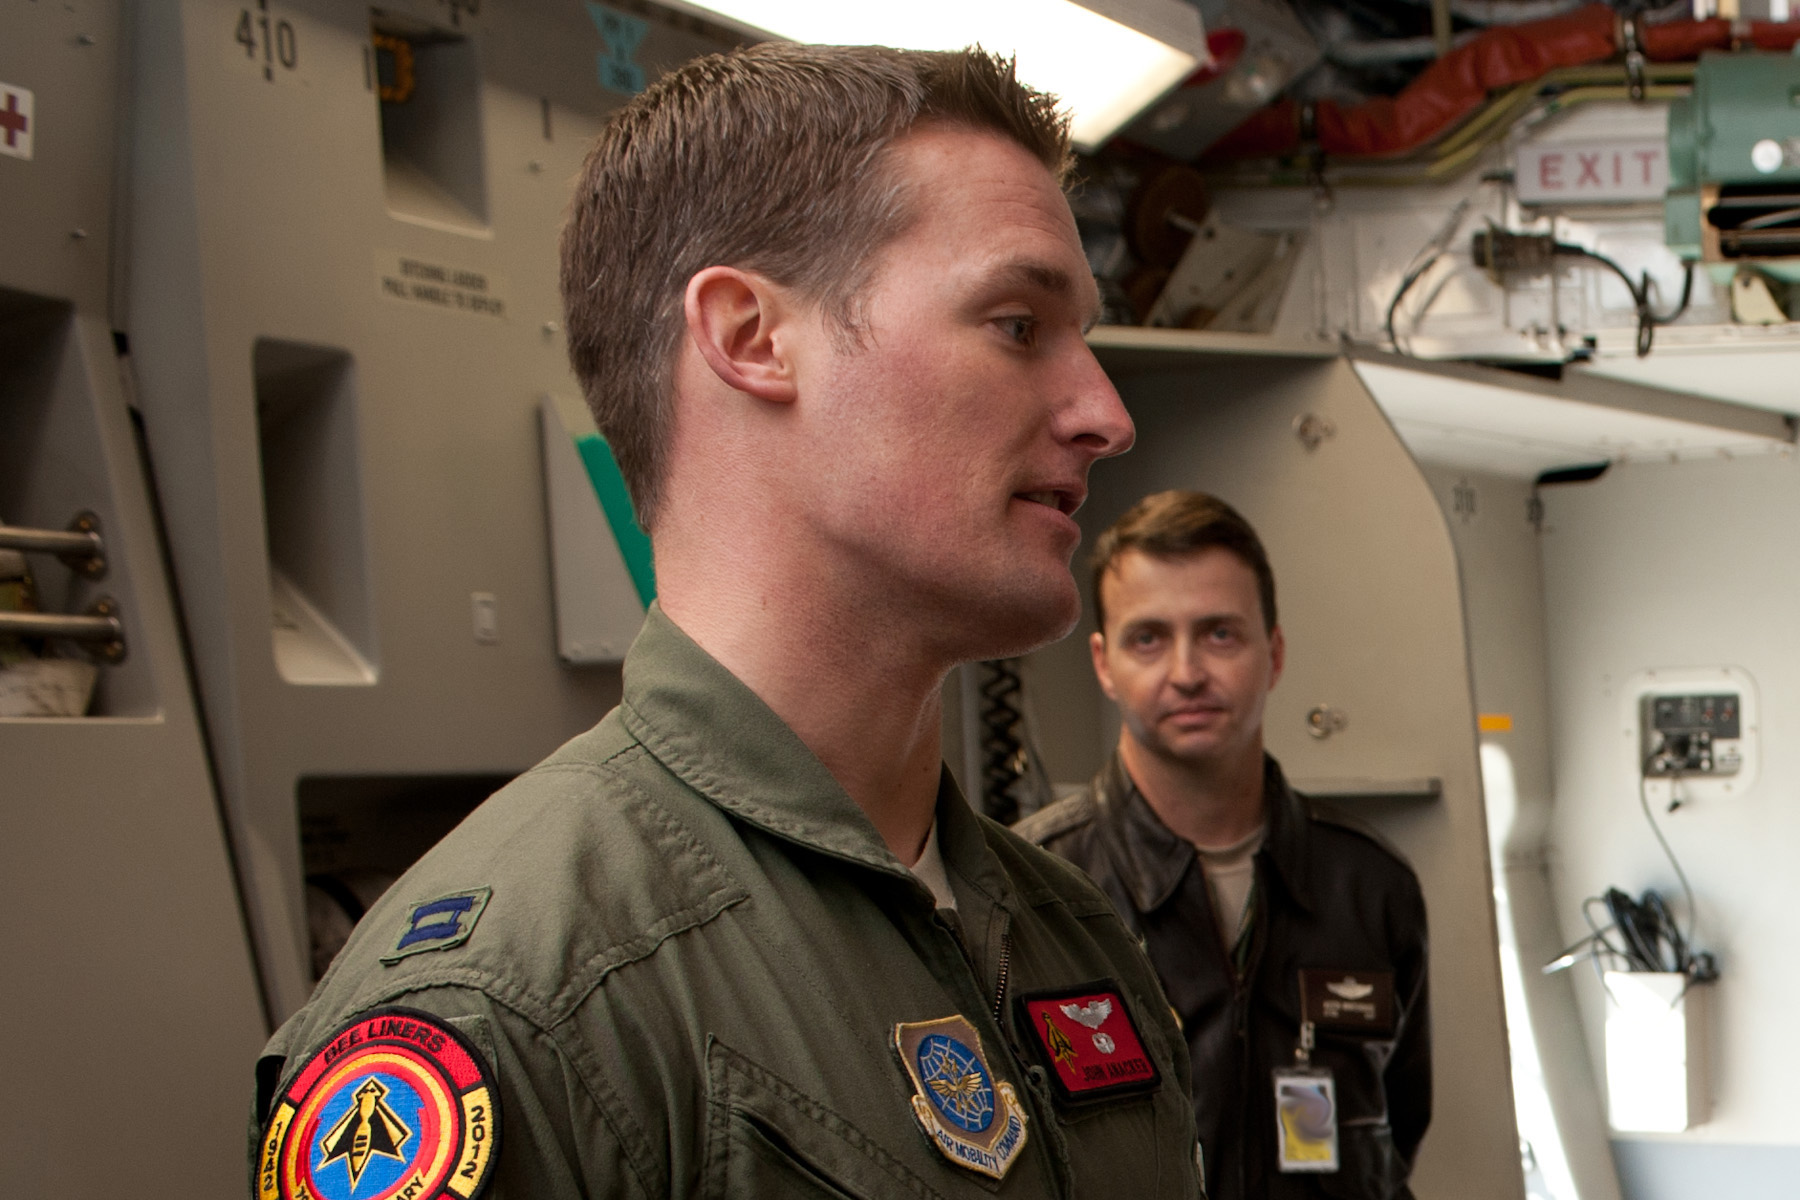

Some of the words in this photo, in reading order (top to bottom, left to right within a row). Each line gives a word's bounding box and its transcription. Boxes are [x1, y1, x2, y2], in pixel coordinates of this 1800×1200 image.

[235, 9, 298, 71] 410
[1538, 151, 1661, 190] EXIT
[323, 1027, 364, 1064] BEE
[367, 1018, 446, 1053] LINERS
[263, 1120, 284, 1191] 1942
[460, 1104, 486, 1180] 2012
[937, 1129, 953, 1151] AIR
[955, 1141, 1000, 1172] MOBILITY
[995, 1115, 1022, 1160] COMMAND
